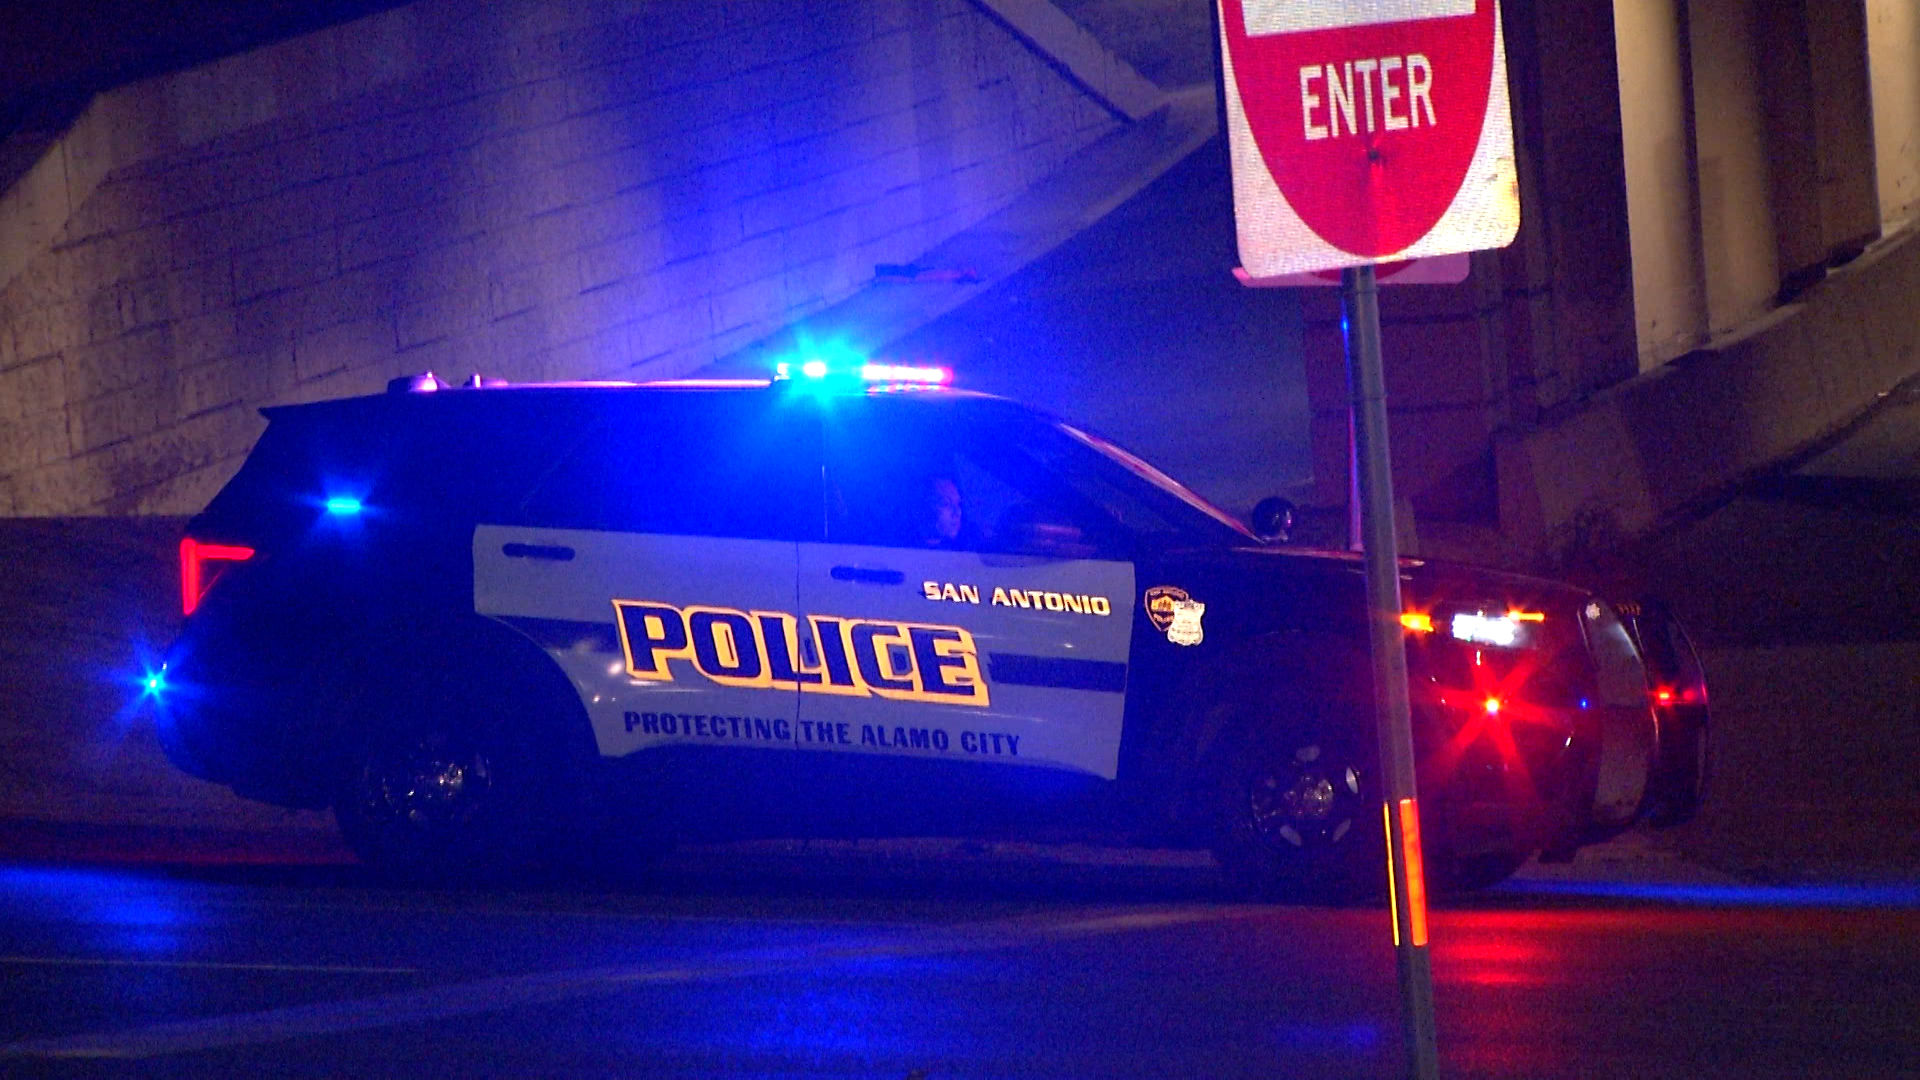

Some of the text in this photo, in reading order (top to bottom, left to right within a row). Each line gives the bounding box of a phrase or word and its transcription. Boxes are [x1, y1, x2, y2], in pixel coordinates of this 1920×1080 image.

[1300, 53, 1436, 140] ENTER
[923, 581, 1111, 616] SAN ANTONIO
[612, 599, 989, 706] POLICE
[624, 711, 1020, 756] PROTECTING THE ALAMO CITY
